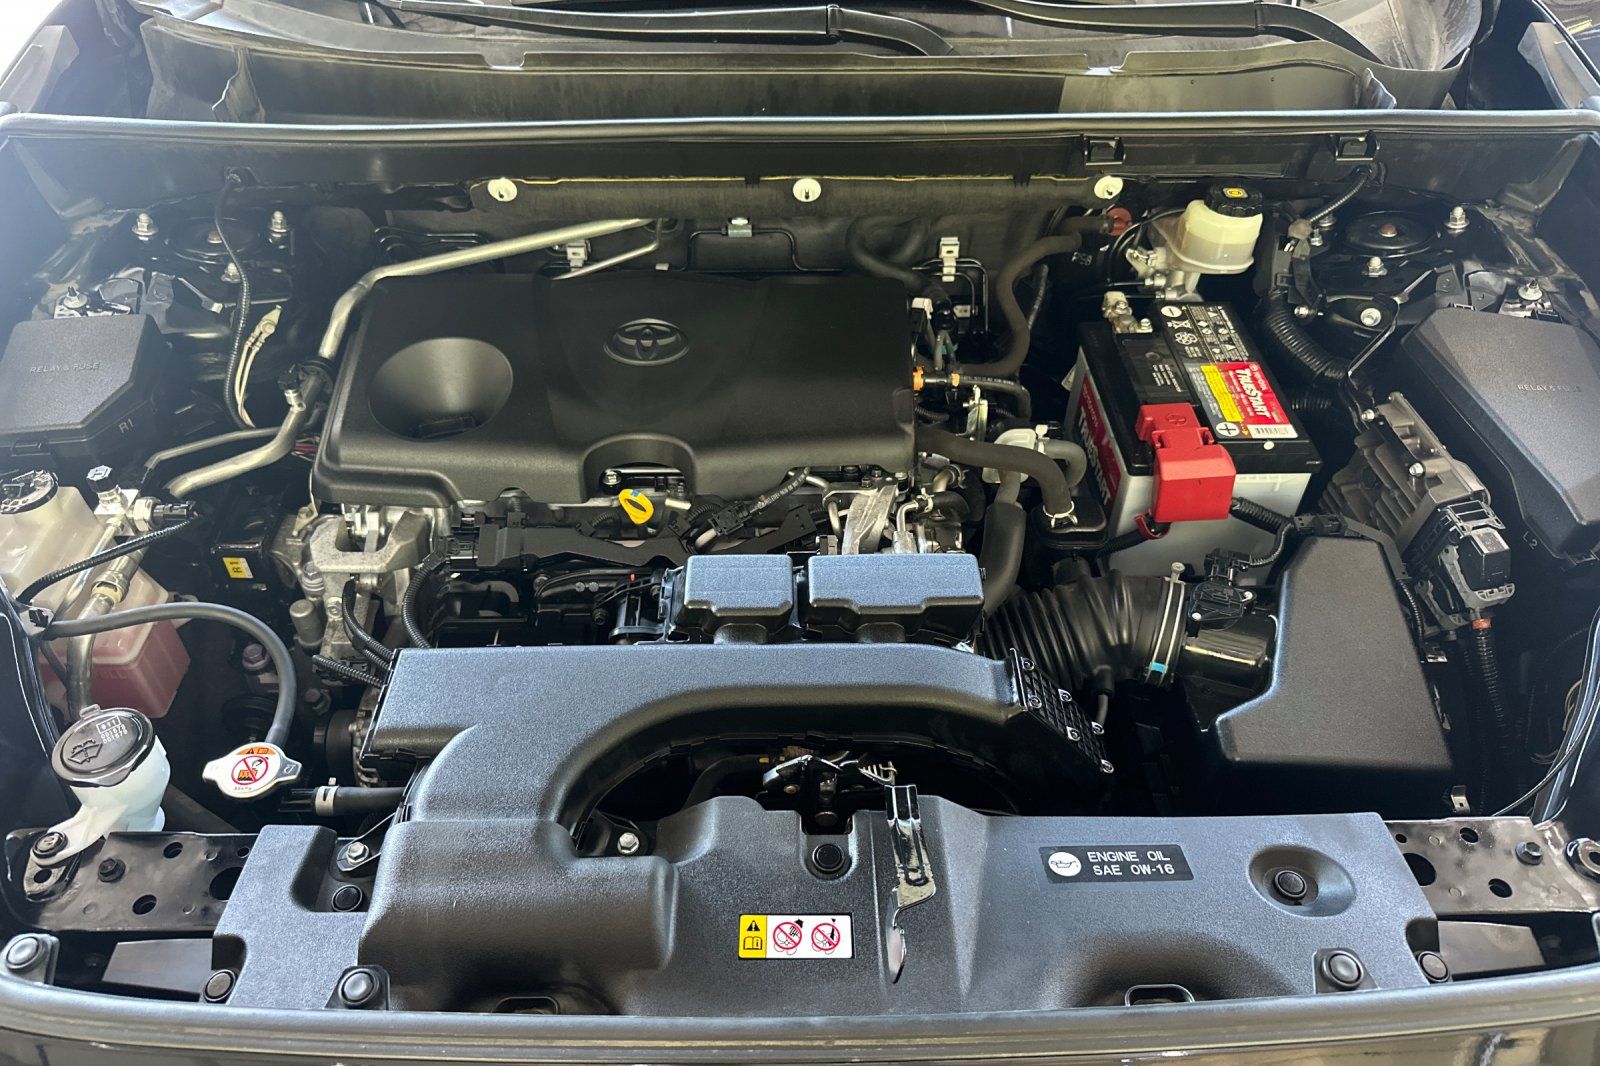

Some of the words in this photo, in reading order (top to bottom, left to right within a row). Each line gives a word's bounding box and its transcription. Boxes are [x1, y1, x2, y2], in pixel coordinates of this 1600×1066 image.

[30, 365, 60, 374] RELAY
[73, 362, 100, 370] FUSE
[119, 418, 134, 433] R1
[1087, 851, 1139, 862] ENGINE
[1147, 851, 1171, 861] OIL
[1093, 864, 1122, 876] SAE
[1130, 863, 1175, 875] 0W-16
